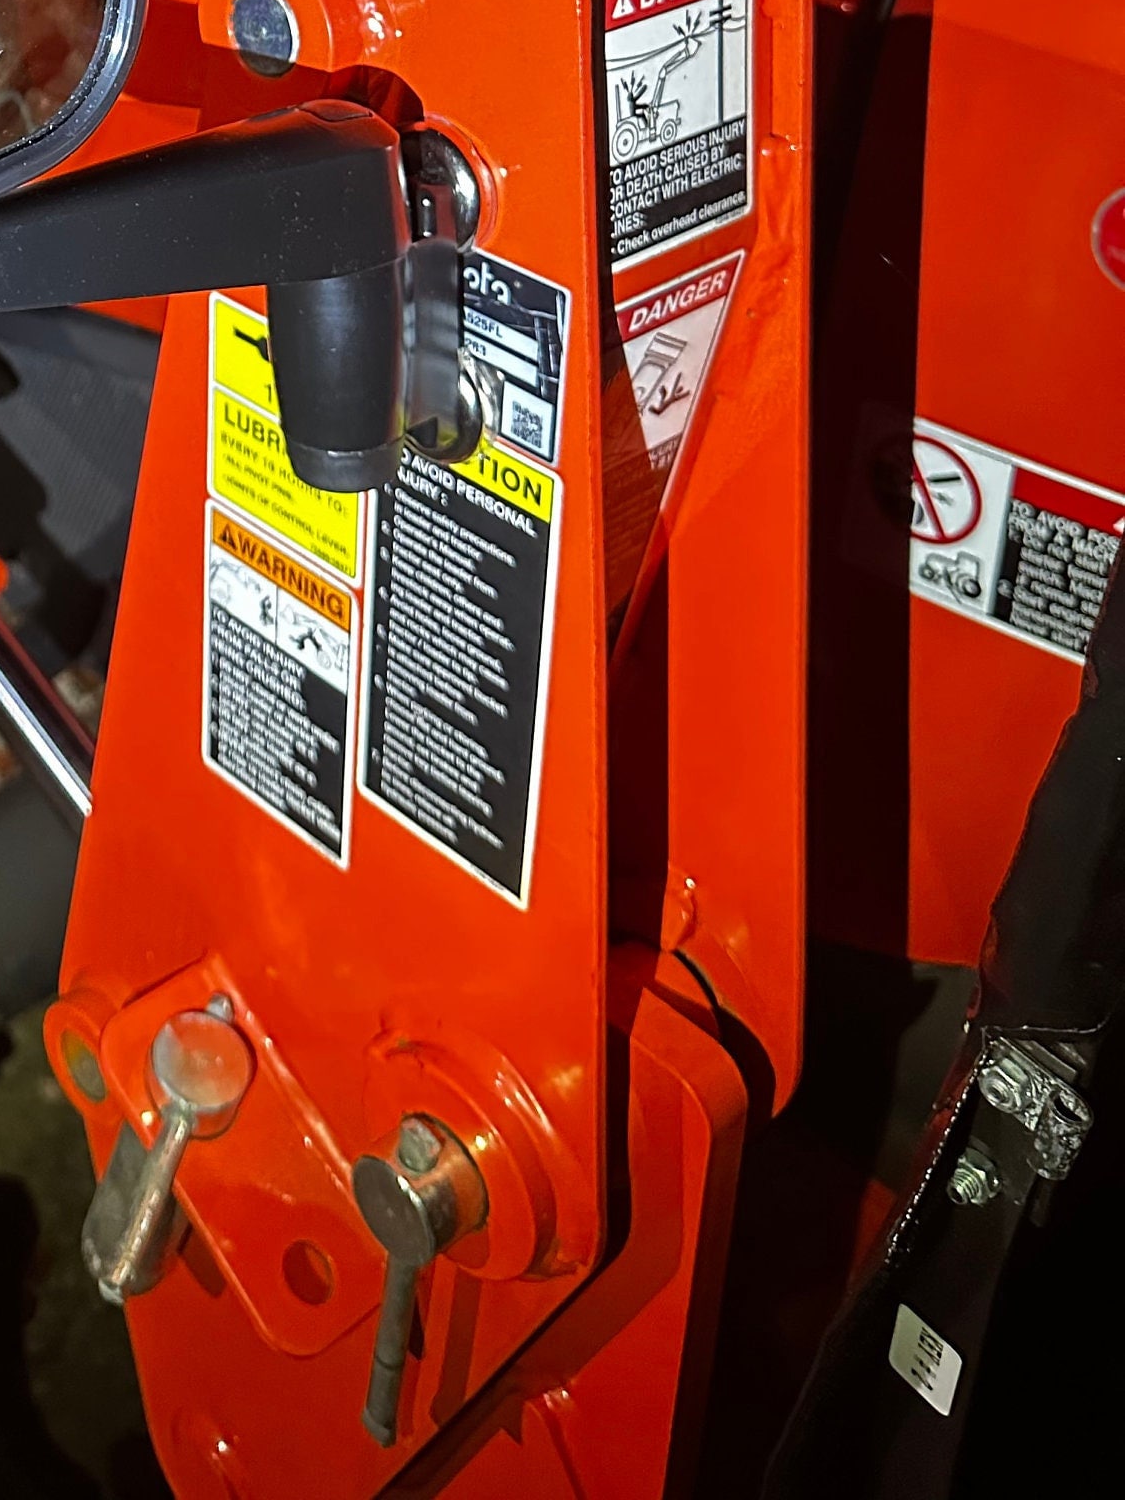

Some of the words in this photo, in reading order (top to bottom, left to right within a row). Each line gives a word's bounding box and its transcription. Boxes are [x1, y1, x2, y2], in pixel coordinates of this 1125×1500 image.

[611, 169, 622, 185] O
[624, 155, 657, 181] AVOID
[660, 134, 707, 166] SERIOUS
[709, 120, 745, 146] INJURY
[626, 169, 662, 197] DEATH
[665, 152, 708, 181] CAUSED
[710, 145, 726, 162] BY
[662, 178, 688, 199] WITH
[691, 154, 744, 187] ELECTRIC
[611, 212, 646, 238] INES:
[617, 230, 650, 254] Check
[651, 207, 697, 240] overhead
[463, 311, 502, 338] 525FL
[629, 270, 727, 332] DANGER
[394, 486, 431, 519] Observe
[431, 508, 459, 536] safety
[401, 448, 412, 465] O
[412, 455, 456, 490] AVOID
[457, 479, 538, 540] PERSONAL
[238, 540, 344, 619] WARNING
